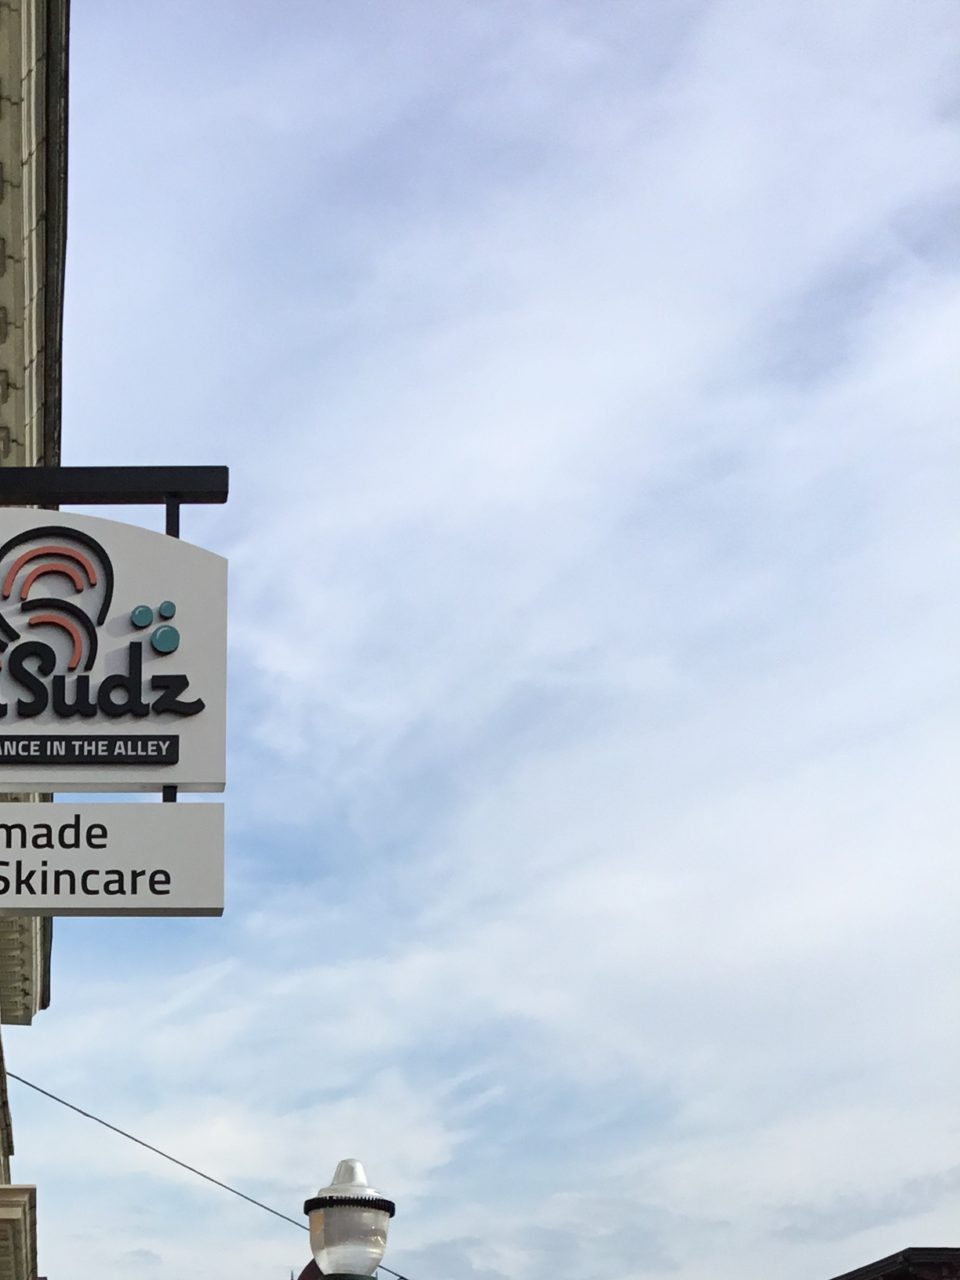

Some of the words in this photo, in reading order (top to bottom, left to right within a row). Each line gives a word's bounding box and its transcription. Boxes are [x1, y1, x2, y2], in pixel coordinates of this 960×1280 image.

[47, 740, 66, 757] IN
[72, 740, 108, 757] THE
[114, 740, 172, 757] ALLEY
